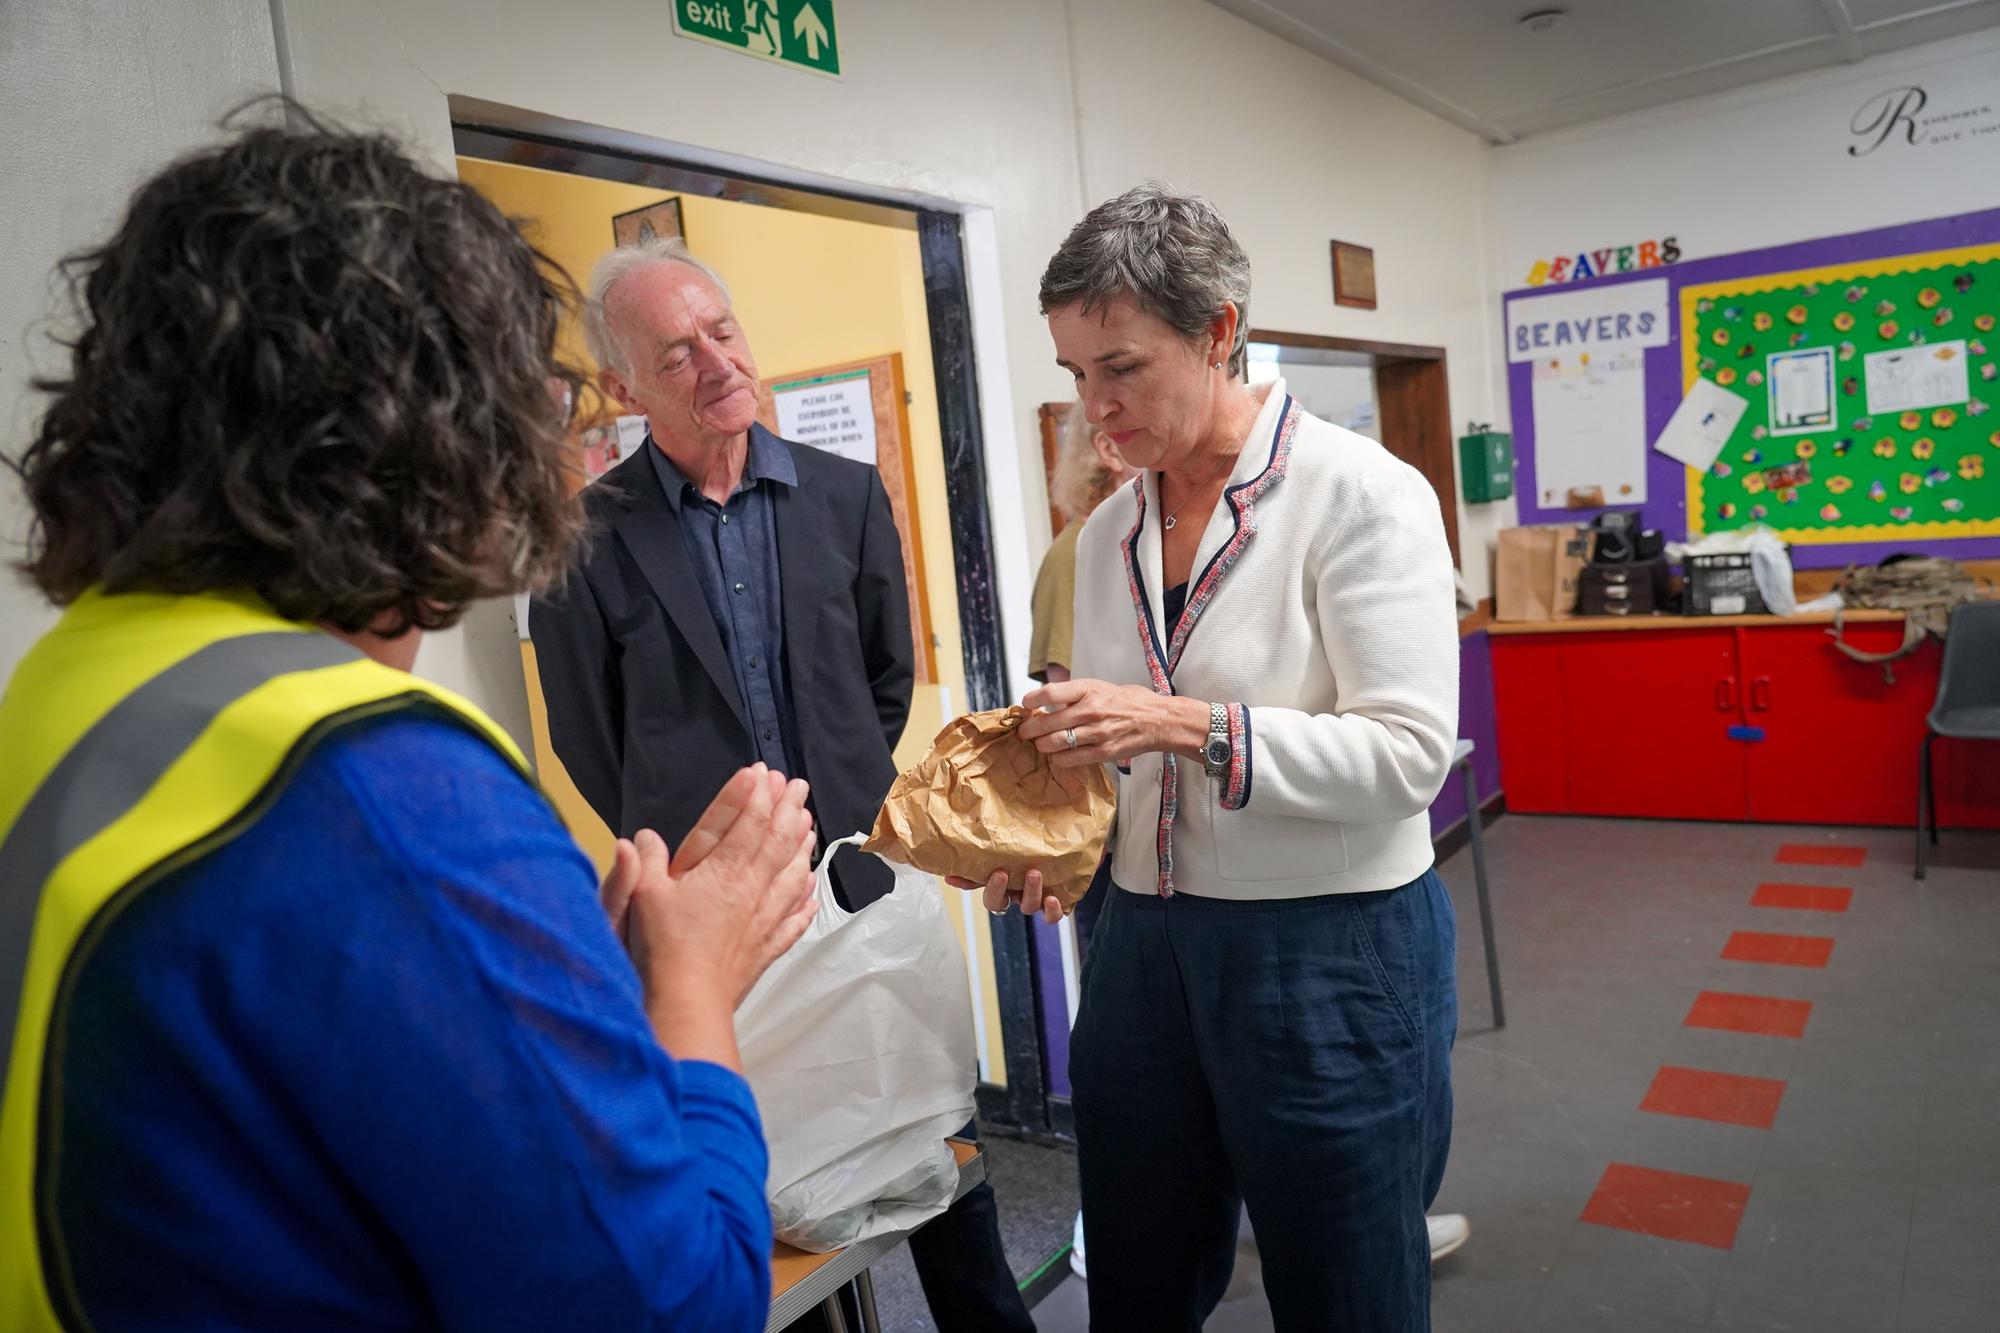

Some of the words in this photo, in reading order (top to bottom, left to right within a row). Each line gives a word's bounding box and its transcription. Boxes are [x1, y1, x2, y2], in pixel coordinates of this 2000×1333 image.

[686, 0, 733, 33] exit
[1527, 237, 1681, 286] BEAVERS
[1516, 311, 1656, 352] BEAVERS
